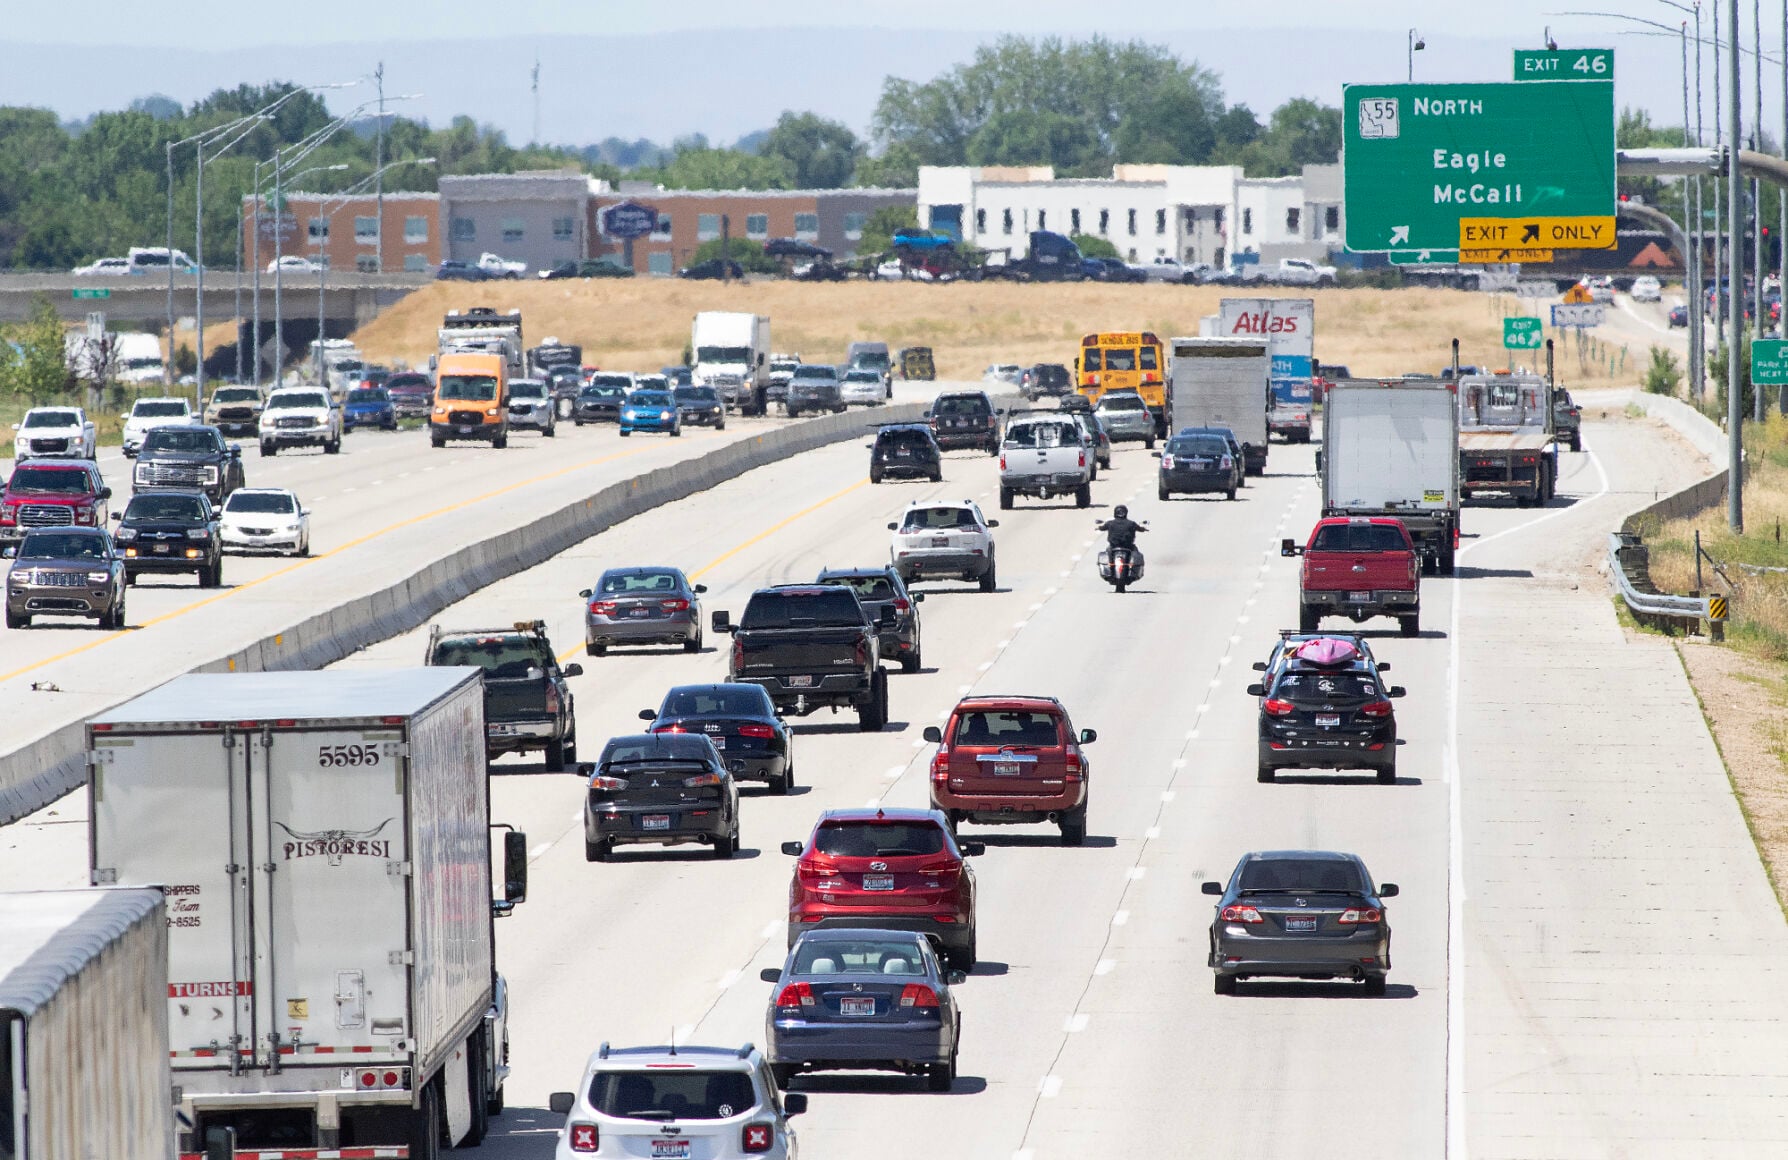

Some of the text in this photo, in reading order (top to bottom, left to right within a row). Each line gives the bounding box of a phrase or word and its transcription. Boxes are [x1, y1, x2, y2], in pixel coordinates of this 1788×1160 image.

[1524, 55, 1607, 73] EXIT 46
[1374, 101, 1395, 120] 55
[1414, 97, 1483, 116] NORTH
[1433, 149, 1507, 174] Eagle
[1433, 184, 1522, 204] McCall
[1466, 225, 1602, 241] EXIT ONLY
[1232, 311, 1298, 334] Atlas
[1126, 336, 1139, 345] BUS
[1506, 333, 1526, 345] 46
[319, 744, 380, 768] 5595
[284, 839, 391, 861] PISTORESI
[164, 885, 200, 896] SHIPPERS
[172, 898, 200, 912] Team
[174, 983, 239, 997] TURNS
[660, 1125, 681, 1134] Jeep
